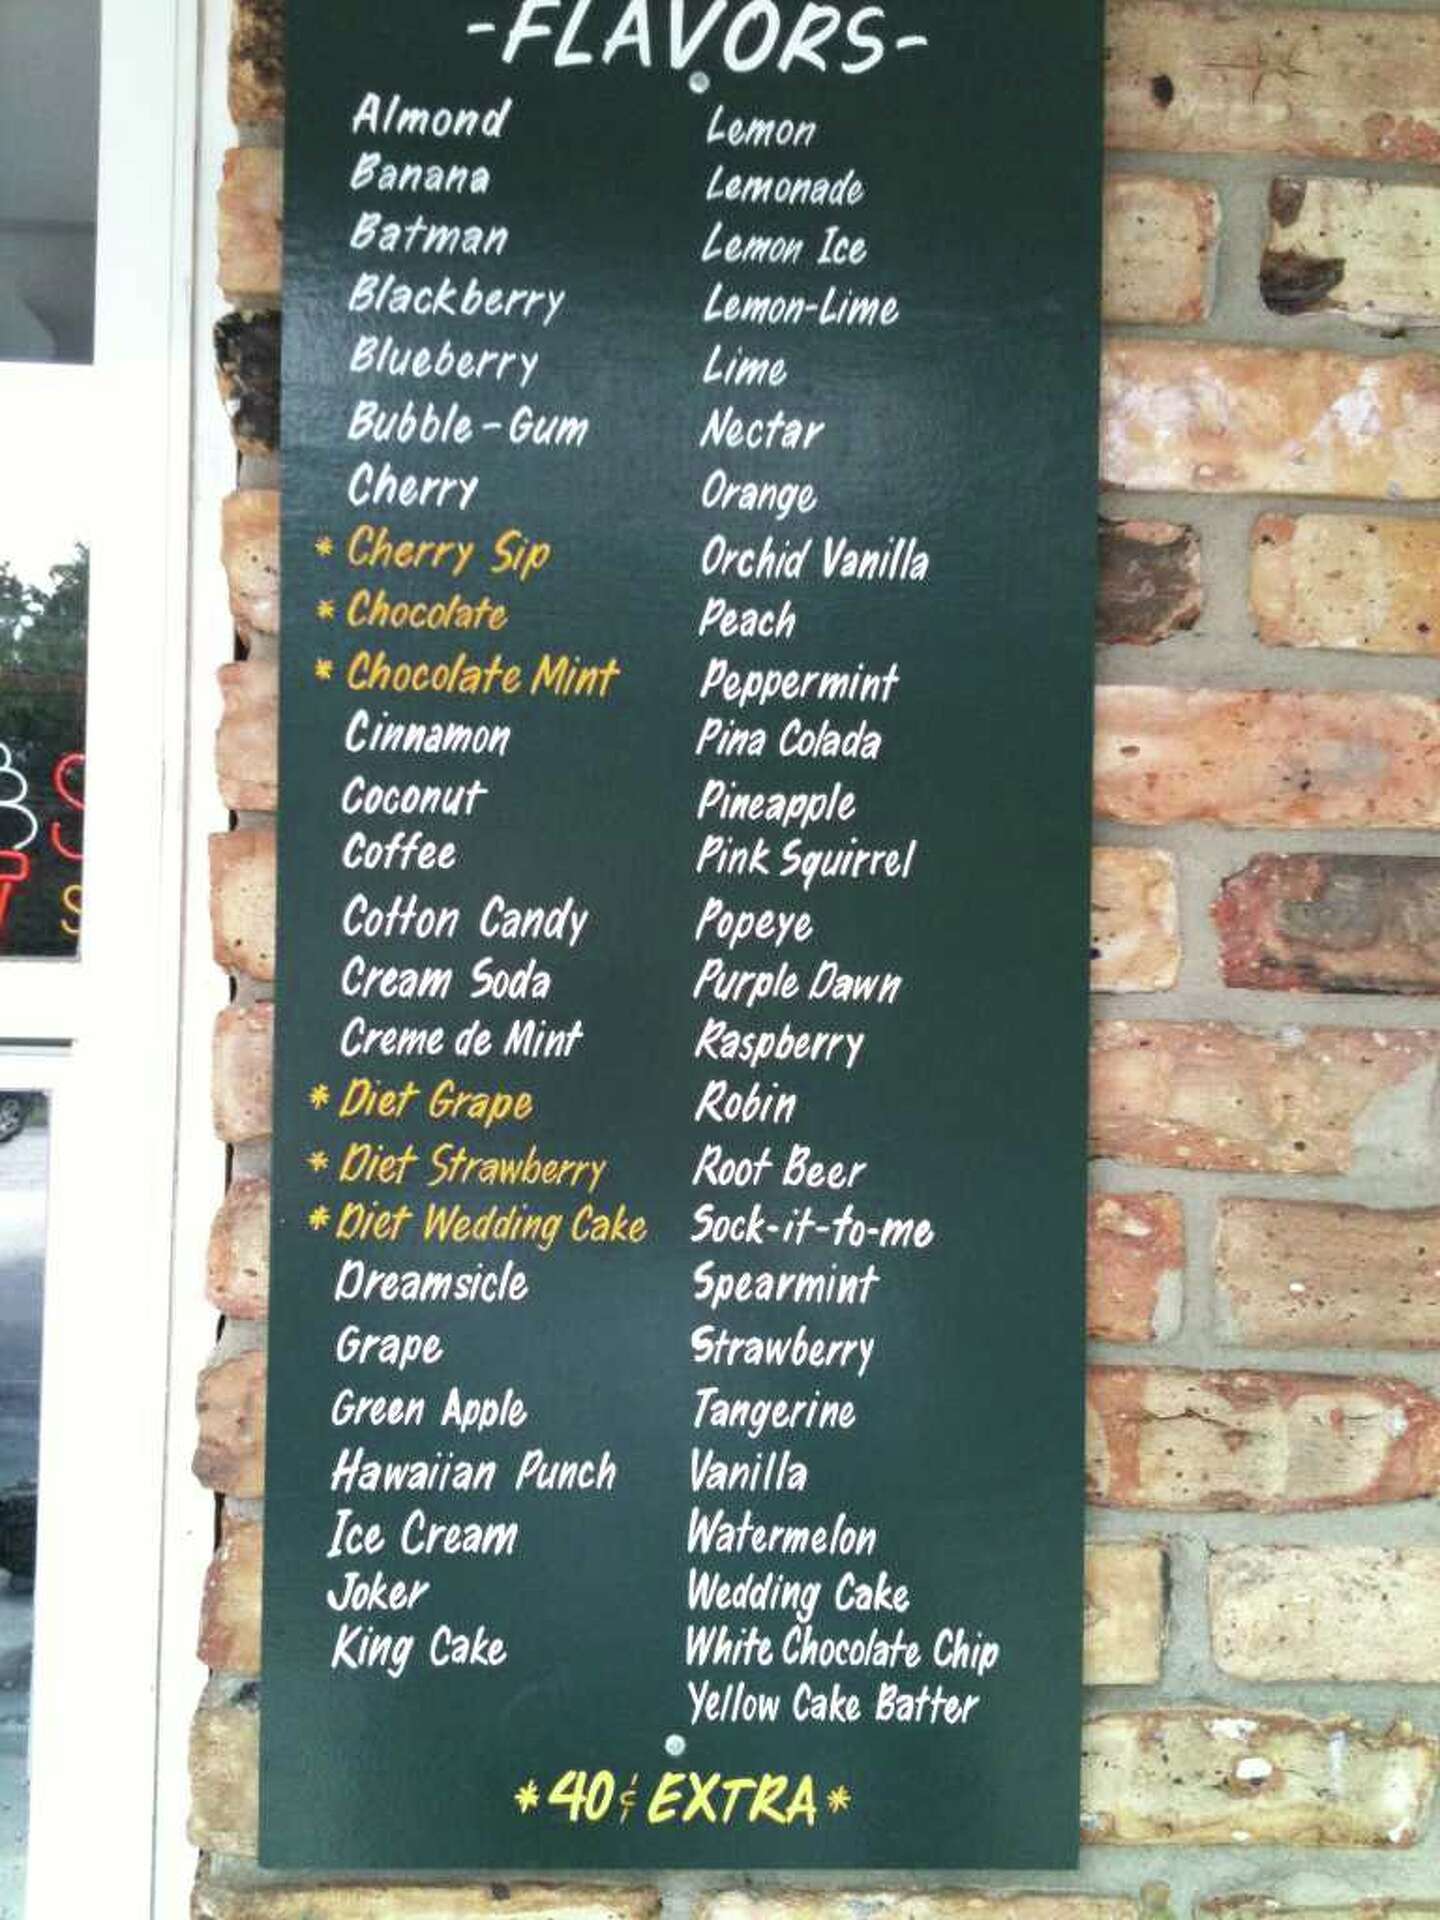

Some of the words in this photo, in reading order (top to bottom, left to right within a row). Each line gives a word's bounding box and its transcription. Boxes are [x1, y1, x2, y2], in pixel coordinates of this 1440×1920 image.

[351, 91, 513, 138] Almond
[706, 104, 817, 147] Lemon
[349, 151, 491, 194] Banana
[705, 164, 865, 206] Lemonade
[349, 211, 509, 256] Batman
[701, 220, 804, 264] Lemon
[817, 224, 868, 265] Ice
[348, 271, 566, 327] Blackberry
[703, 281, 900, 326] Lemon-Lime
[349, 335, 539, 388] Blueberry
[702, 343, 788, 387] Lime
[699, 405, 826, 450] Nectar
[347, 461, 480, 511] Cherry
[701, 468, 818, 521] Orange
[348, 524, 474, 575] Cherry
[491, 529, 550, 581] Sip
[701, 533, 813, 579] Orchid
[823, 535, 930, 581] Vanilla
[347, 589, 508, 631] Chocolate
[698, 596, 796, 639] Peach
[347, 650, 521, 694] Chocolate
[530, 654, 621, 697] Mint
[699, 657, 901, 709] Peppermint
[344, 708, 511, 757] Cinnamon
[694, 716, 767, 757] Pina
[779, 717, 883, 760] Colada
[341, 774, 489, 816] Coconut
[696, 778, 856, 830] Pineapple
[341, 830, 456, 871] Coffee
[695, 834, 771, 875] Pink
[779, 836, 918, 892] Squirrel
[342, 892, 460, 939] Cotton
[479, 894, 590, 948] Candy
[694, 895, 814, 951] Popeye
[341, 954, 453, 1000] Cream
[470, 956, 552, 1000] Soda
[692, 957, 800, 1009] Purple
[807, 959, 903, 1004] Dawn
[340, 1015, 445, 1058] Creme
[454, 1019, 493, 1057] de
[503, 1019, 585, 1058] Mint
[694, 1016, 865, 1070] Raspberry
[338, 1077, 421, 1118] Diet
[429, 1078, 533, 1129] Grape
[694, 1079, 797, 1124] Robin
[339, 1142, 419, 1184] Diet
[427, 1142, 607, 1193] Strawberry
[691, 1143, 774, 1187] Root
[781, 1143, 868, 1190] Beer
[335, 1200, 414, 1240] Diet
[424, 1203, 563, 1252] Wedding
[571, 1203, 648, 1243] Cake
[690, 1203, 936, 1249] Sock-it-to-me
[334, 1258, 529, 1303] Dreamsicle
[693, 1259, 881, 1311] Spearmint
[336, 1324, 444, 1371] Grape
[690, 1324, 875, 1378] Strawberry
[331, 1387, 425, 1426] Green
[440, 1386, 528, 1434] Apple
[693, 1386, 856, 1439] Tangerine
[330, 1446, 497, 1494] Hawaiian
[514, 1448, 617, 1491] Punch
[691, 1446, 808, 1492] Vanilla
[325, 1508, 386, 1559] Ice
[400, 1508, 519, 1556] Cream
[687, 1505, 877, 1556] Watermelon
[326, 1570, 431, 1612] Joker
[687, 1566, 822, 1624] Wedding
[834, 1570, 911, 1613] Cake
[330, 1623, 415, 1679] King
[429, 1624, 508, 1667] Cake
[685, 1624, 774, 1666] White
[781, 1623, 922, 1669] Chocolate
[933, 1627, 1000, 1677] Chip
[687, 1679, 781, 1726] Yellow
[792, 1681, 862, 1723] Cake
[874, 1681, 981, 1725] Batter
[647, 1771, 818, 1827] EXTRA
